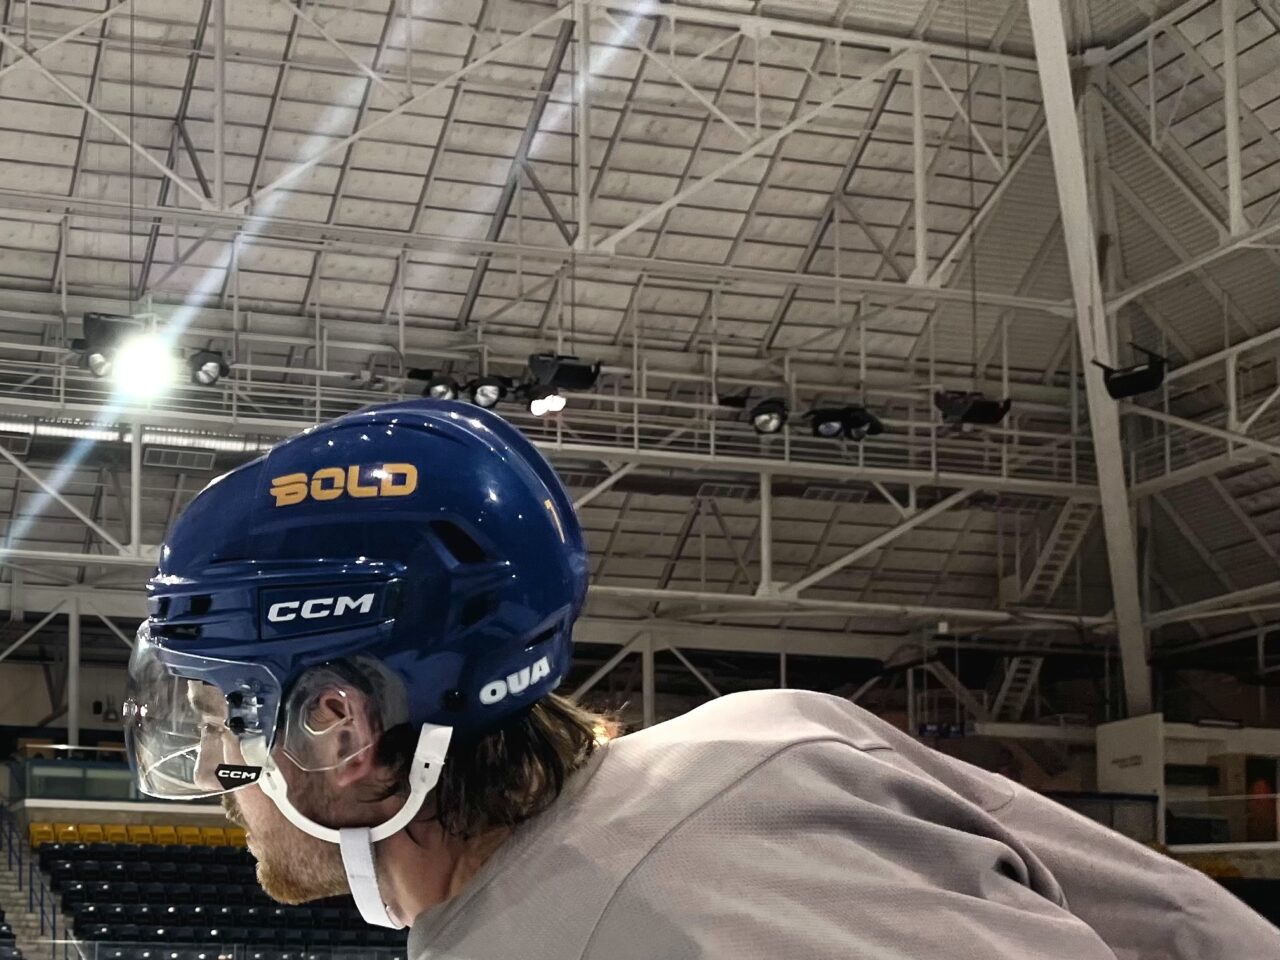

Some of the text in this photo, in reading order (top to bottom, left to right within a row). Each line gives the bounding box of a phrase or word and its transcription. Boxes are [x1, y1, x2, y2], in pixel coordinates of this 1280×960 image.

[270, 463, 418, 507] BOLD
[267, 593, 375, 622] CCM
[479, 656, 551, 705] OUA
[218, 769, 256, 780] CCM
